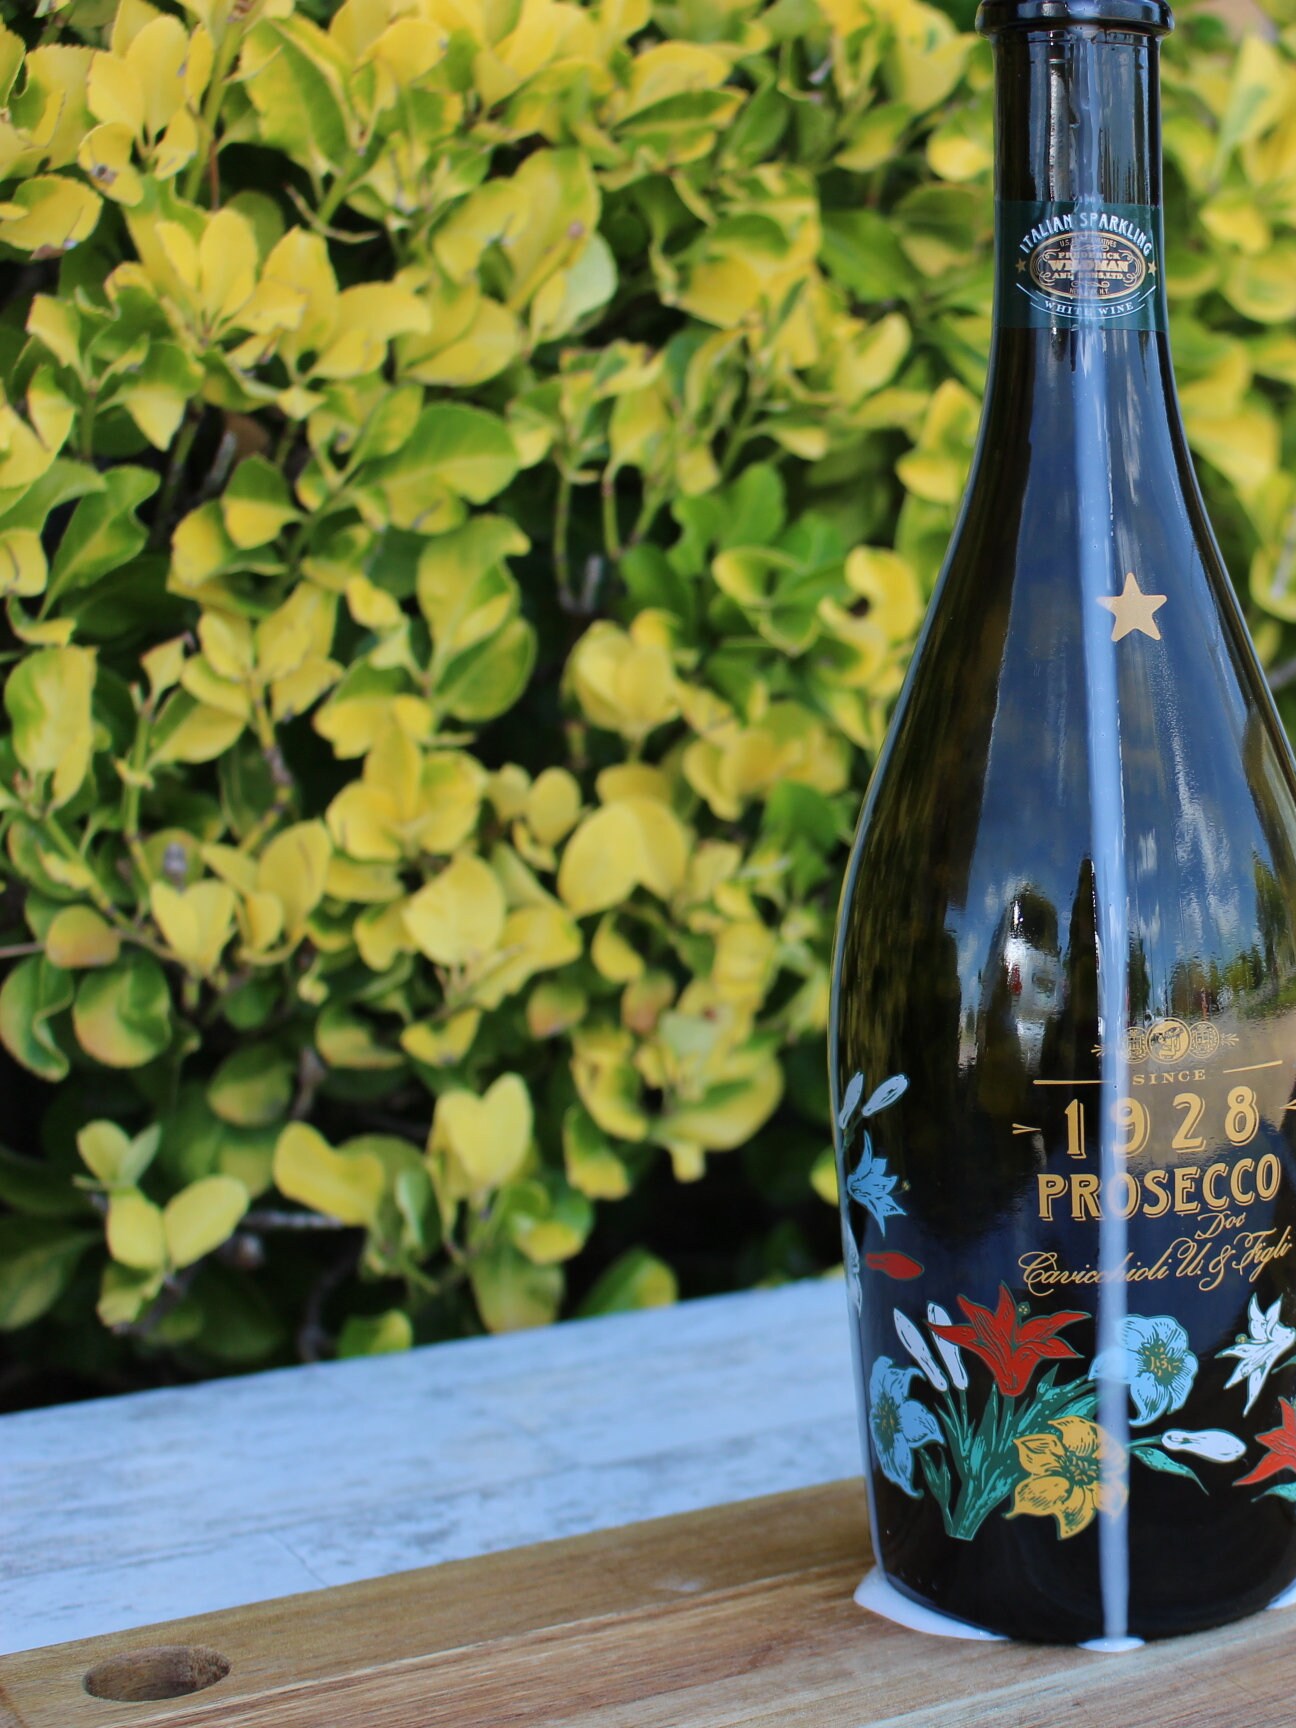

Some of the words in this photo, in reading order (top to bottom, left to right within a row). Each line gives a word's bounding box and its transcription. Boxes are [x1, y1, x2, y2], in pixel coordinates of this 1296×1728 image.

[1019, 214, 1072, 254] ITALIAN
[1080, 212, 1153, 256] SPARKLING
[1044, 300, 1093, 316] WHITE
[1099, 301, 1134, 316] WINE
[1132, 1069, 1206, 1086] SINCE
[1064, 1086, 1260, 1160] 1928
[1037, 1153, 1281, 1221] PROSECCO
[1199, 1245, 1237, 1291] &
